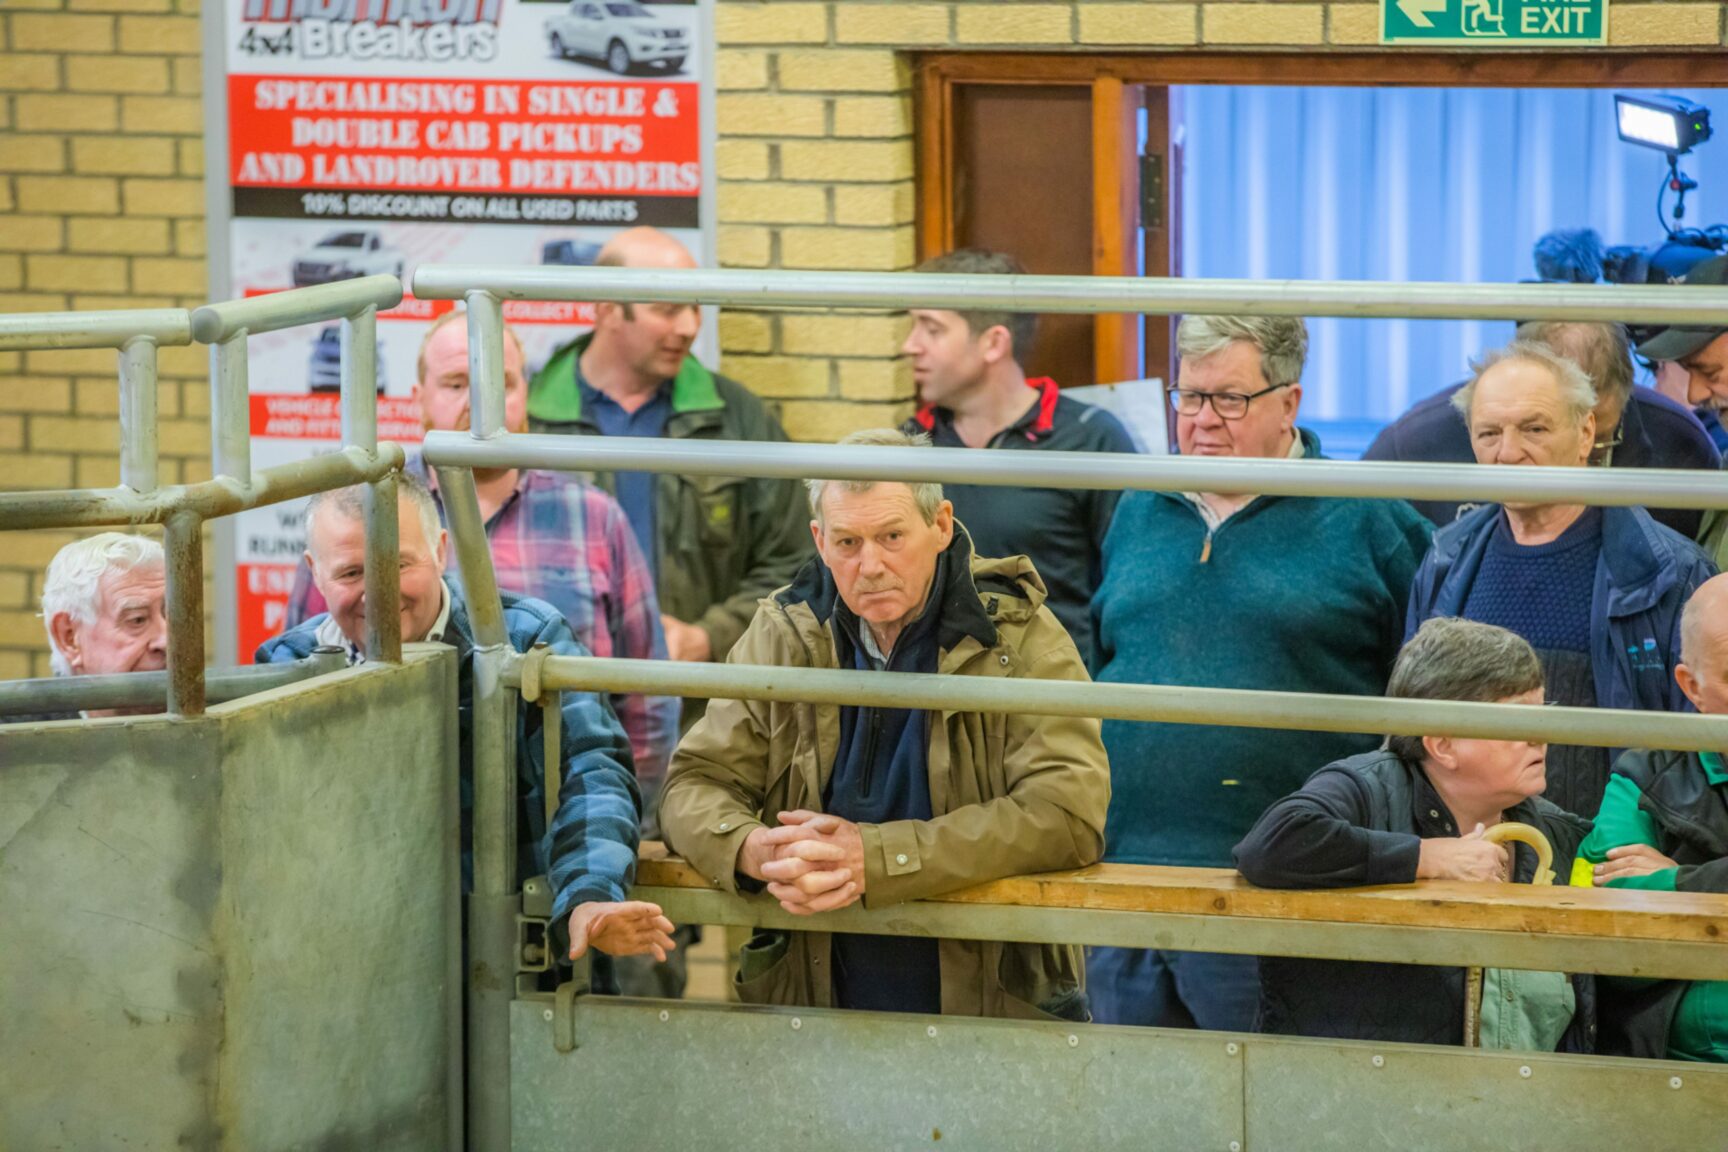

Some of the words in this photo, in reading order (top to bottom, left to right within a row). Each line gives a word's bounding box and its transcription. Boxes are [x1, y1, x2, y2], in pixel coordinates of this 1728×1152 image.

[1521, 7, 1591, 33] EXIT
[239, 27, 293, 54] 4x4
[301, 19, 498, 61] Breakers
[254, 80, 476, 113] SPECIALISING
[483, 85, 520, 114] IN
[528, 87, 646, 117] SINGLE
[652, 88, 679, 117] &
[291, 117, 420, 149] DOUBLE
[425, 120, 490, 151] CAB
[499, 122, 643, 154] PICKUPS
[238, 152, 305, 183] AND
[311, 154, 502, 188] LANDROVER
[510, 159, 700, 191] DEFENDERS
[301, 192, 347, 214] 10%
[348, 193, 450, 217] DISCOUNT
[450, 196, 486, 218] ON
[486, 198, 520, 219] ALL
[521, 198, 575, 220] USED
[575, 200, 638, 221] PARTS
